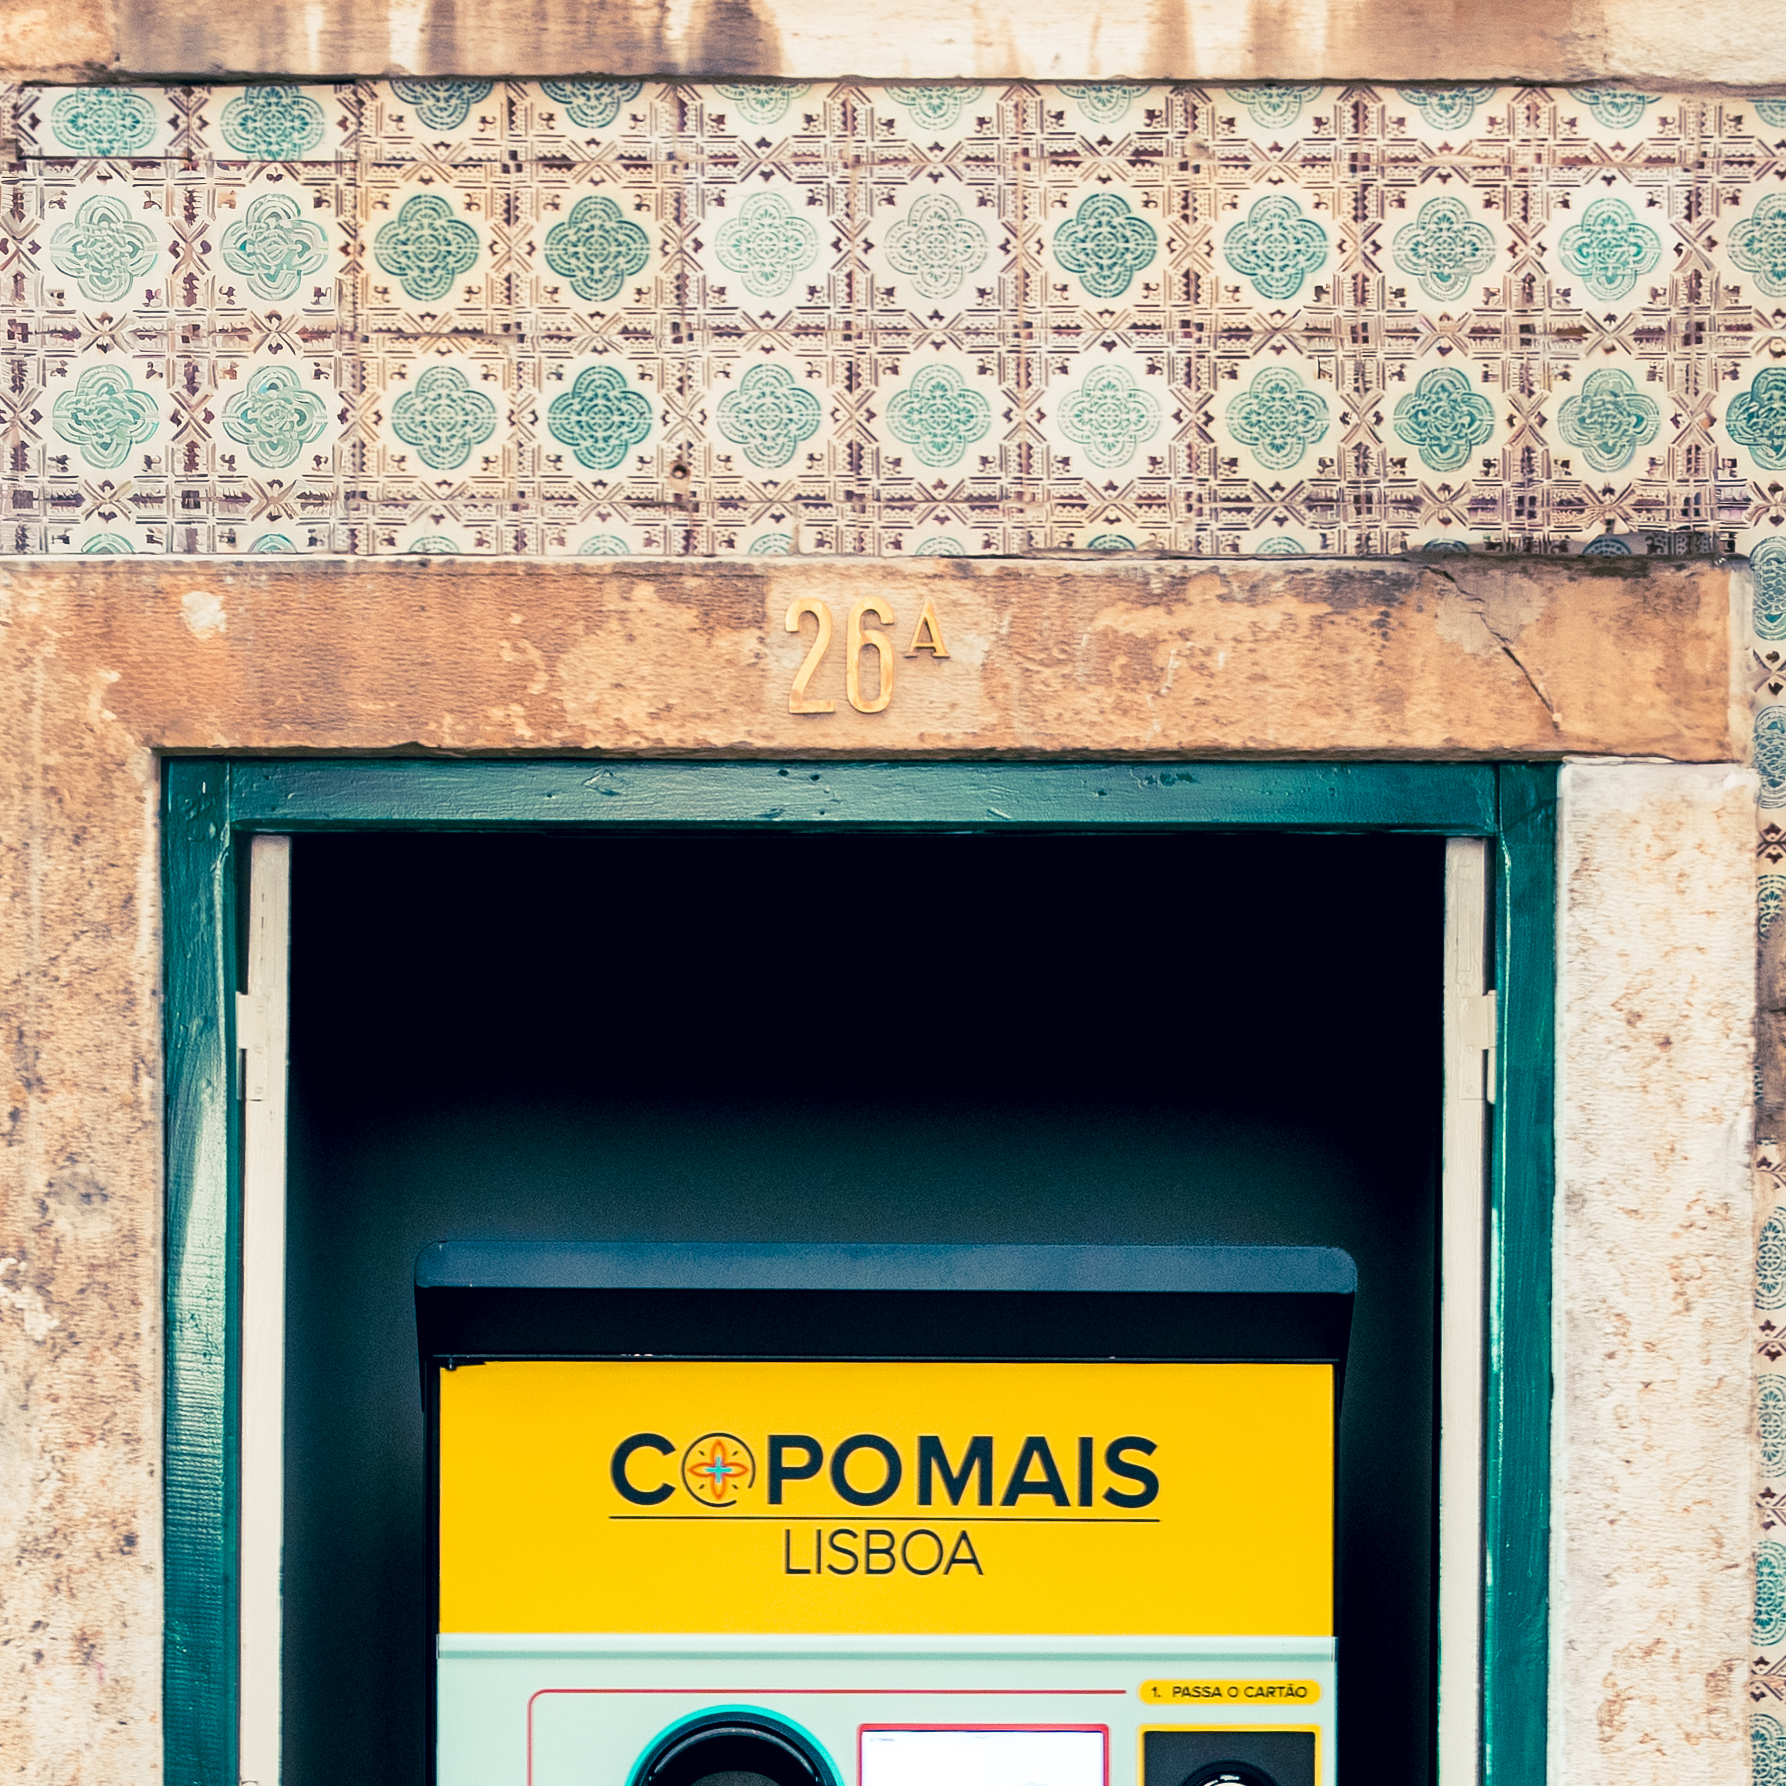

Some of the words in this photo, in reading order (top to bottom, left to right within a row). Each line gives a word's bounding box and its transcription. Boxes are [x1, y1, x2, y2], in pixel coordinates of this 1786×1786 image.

[783, 1527, 985, 1576] LISBOA
[1172, 1685, 1222, 1699] PASSA
[1227, 1685, 1240, 1699] O
[1245, 1682, 1309, 1699] CARTÃO
